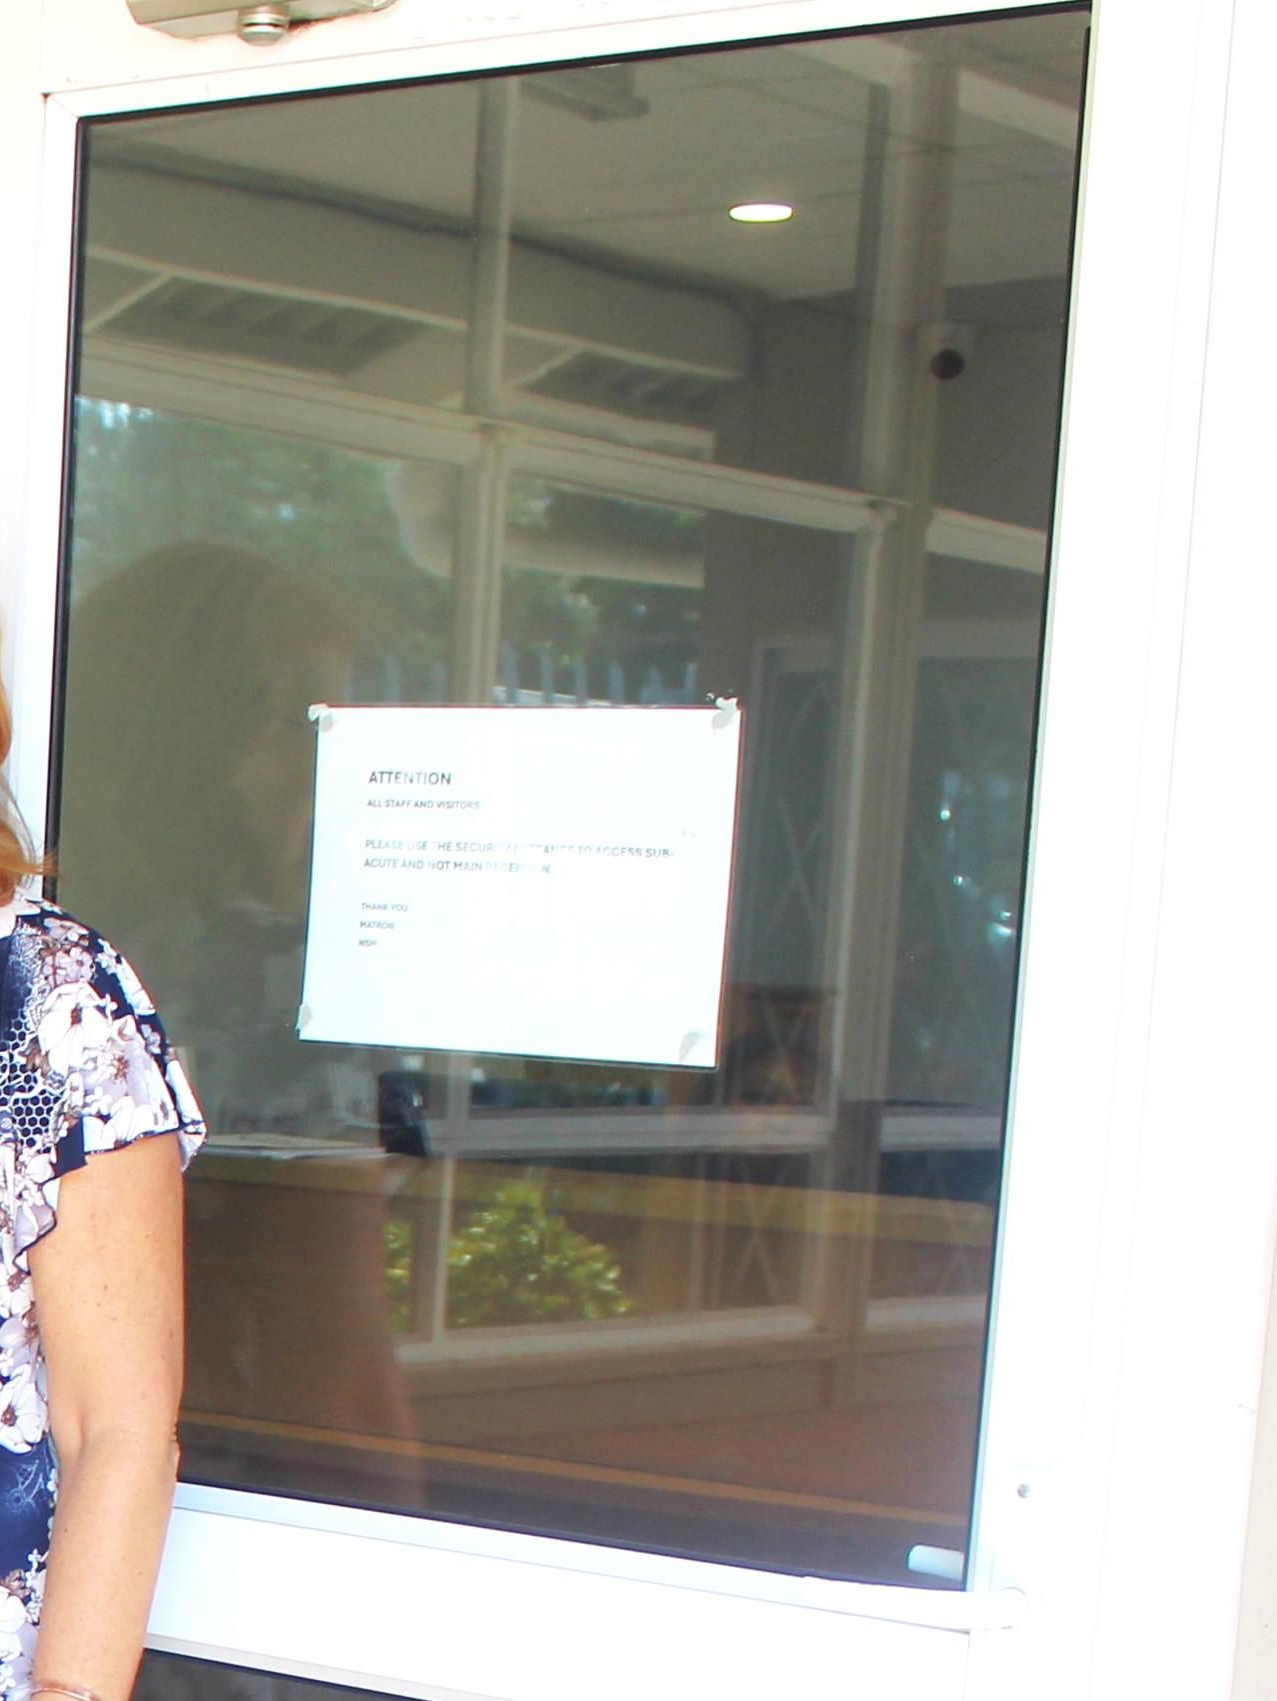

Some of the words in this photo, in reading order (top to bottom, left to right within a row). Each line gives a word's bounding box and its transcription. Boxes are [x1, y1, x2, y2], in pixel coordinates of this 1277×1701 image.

[367, 770, 452, 786] ATTENTION
[366, 799, 384, 808] ALL
[385, 799, 412, 808] STAFF
[413, 800, 435, 809] AND
[436, 800, 480, 810] VISITORS
[363, 858, 399, 869] ACUTE
[400, 859, 425, 870] AND
[453, 860, 483, 872] MAIN
